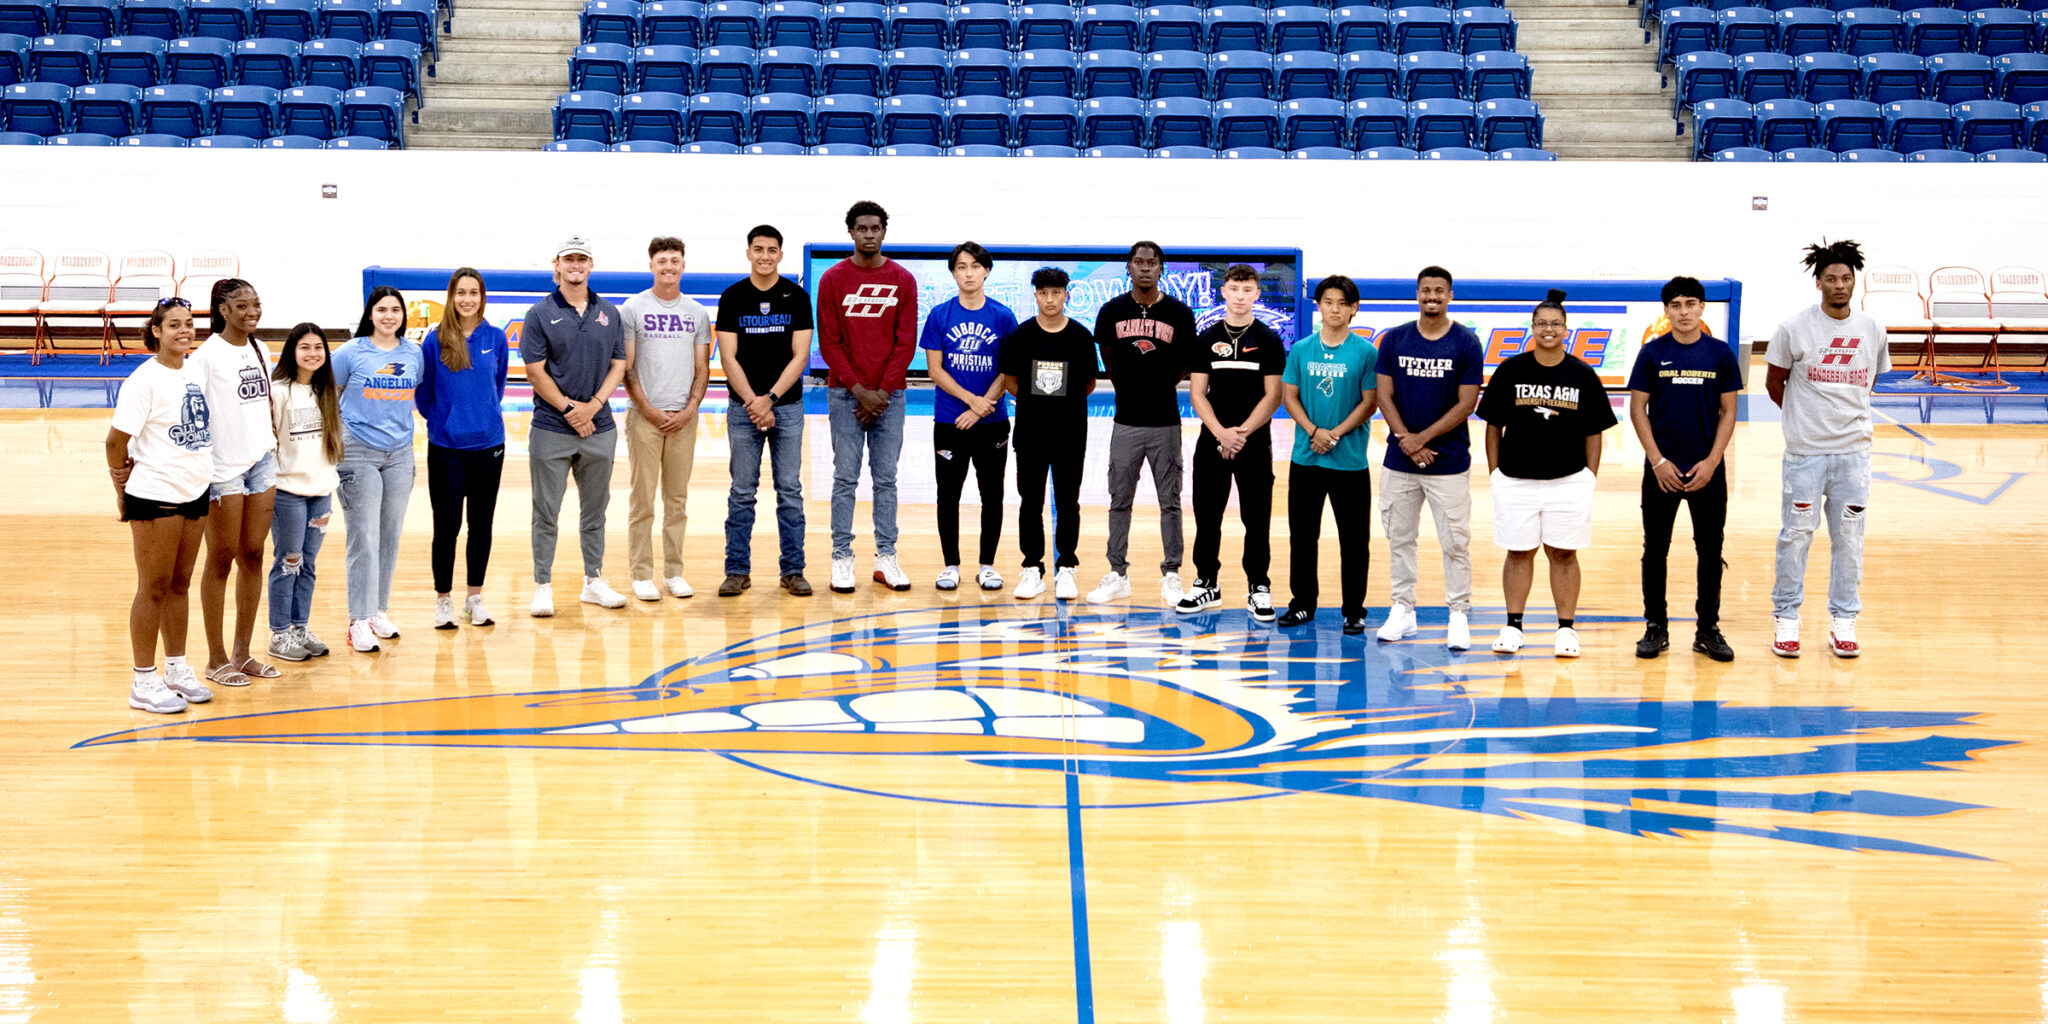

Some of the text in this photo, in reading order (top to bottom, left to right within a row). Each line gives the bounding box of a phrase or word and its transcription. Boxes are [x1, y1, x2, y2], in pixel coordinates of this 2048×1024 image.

[644, 314, 684, 331] SFA
[739, 314, 791, 327] LETOURNEAU
[946, 321, 998, 345] LUBBOCK
[948, 353, 993, 366] CHRISTIAN
[1406, 368, 1445, 378] SOCCER
[1680, 370, 1717, 379] ROBERTS
[1672, 377, 1704, 385] SOCCER
[238, 380, 268, 399] ODU
[1514, 384, 1580, 403] TEXAS A&M
